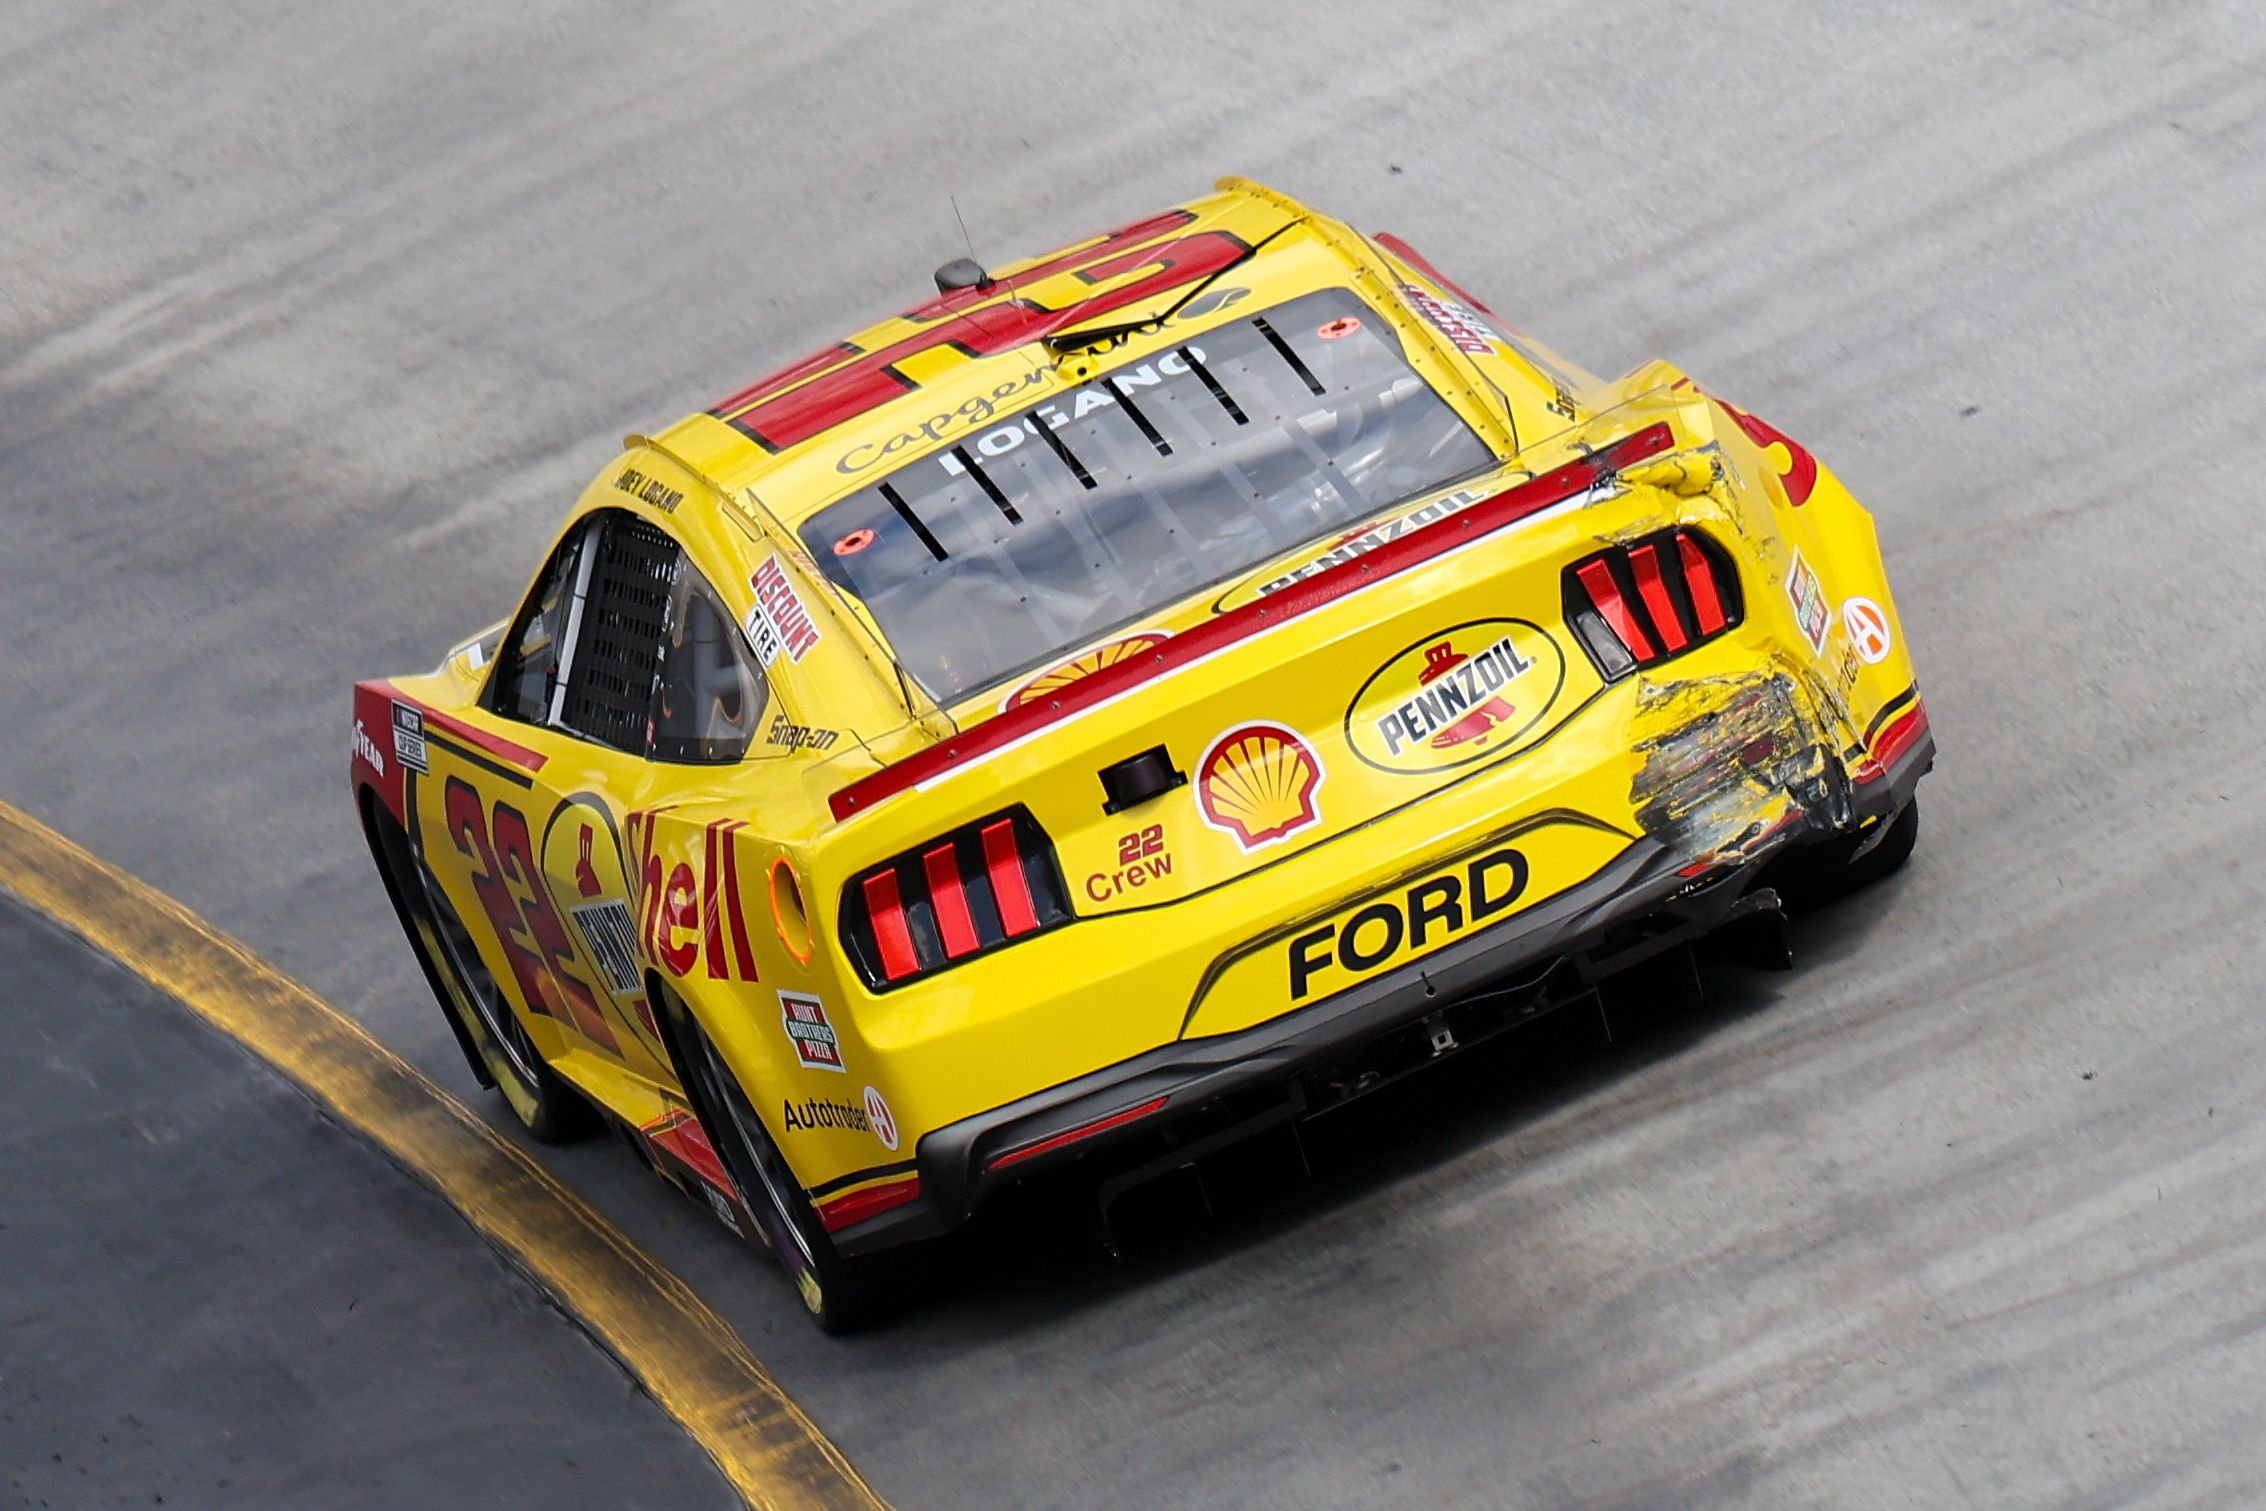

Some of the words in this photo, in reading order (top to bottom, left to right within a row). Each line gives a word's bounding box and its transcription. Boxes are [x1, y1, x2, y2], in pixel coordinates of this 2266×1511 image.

[939, 346, 1207, 476] LOGANO
[750, 555, 819, 662] DISCOUNT
[748, 608, 778, 661] TIRE
[1377, 637, 1530, 757] PENNZOIL
[1118, 823, 1164, 867] 22
[1086, 852, 1172, 902] Crew
[445, 775, 625, 1060] 22
[1289, 848, 1529, 1001] FORD
[789, 1021, 833, 1044] BROTHERS
[791, 1003, 818, 1023] HUNT
[804, 1040, 833, 1060] PIZZA
[784, 1097, 871, 1133] Autotrader
